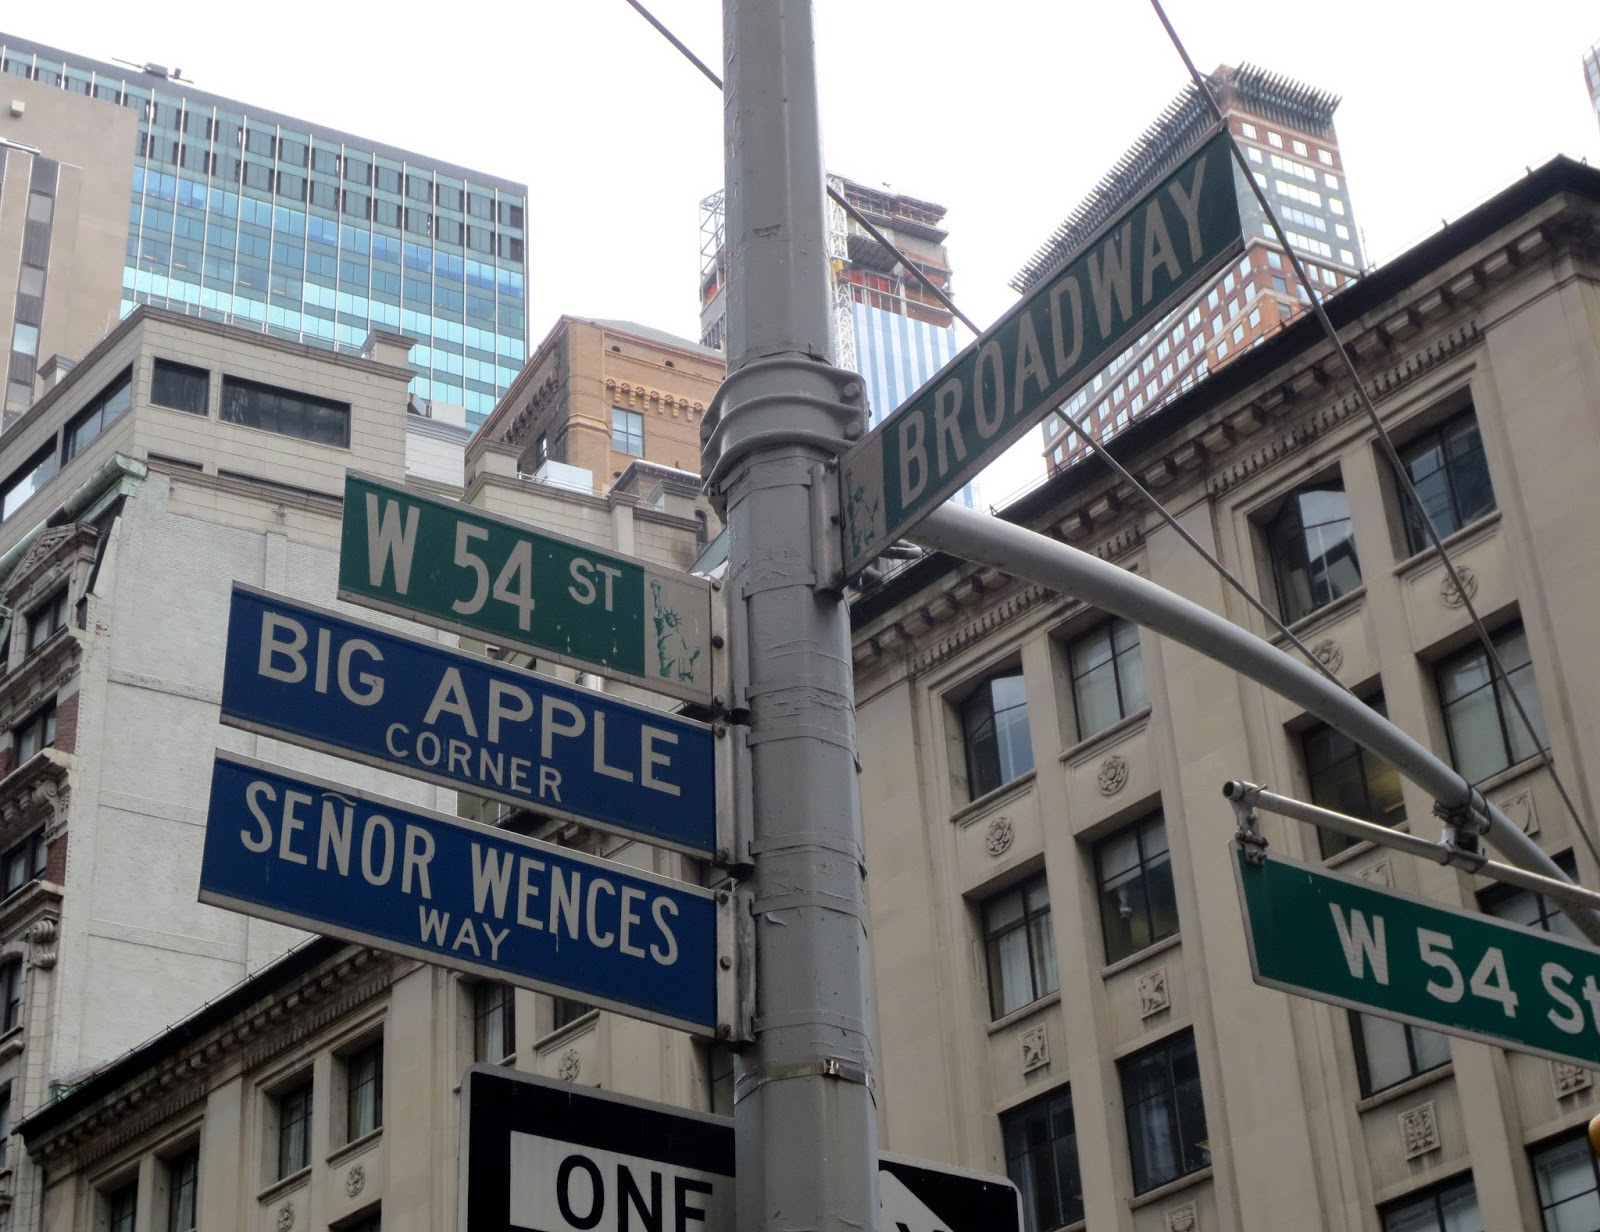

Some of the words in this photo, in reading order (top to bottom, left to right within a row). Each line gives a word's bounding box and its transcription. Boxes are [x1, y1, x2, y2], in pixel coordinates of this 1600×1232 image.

[899, 158, 1206, 509] BROADWAY
[367, 493, 420, 595] W
[452, 521, 535, 631] 54
[568, 558, 622, 611] ST
[258, 611, 386, 706] BIG
[423, 667, 681, 796] APPLE
[386, 724, 562, 802] CORNER
[241, 781, 436, 899] SEÑOR
[471, 843, 679, 966] WENCES
[420, 906, 511, 961] WAY
[1329, 902, 1389, 985] W
[1417, 927, 1518, 1018] 54
